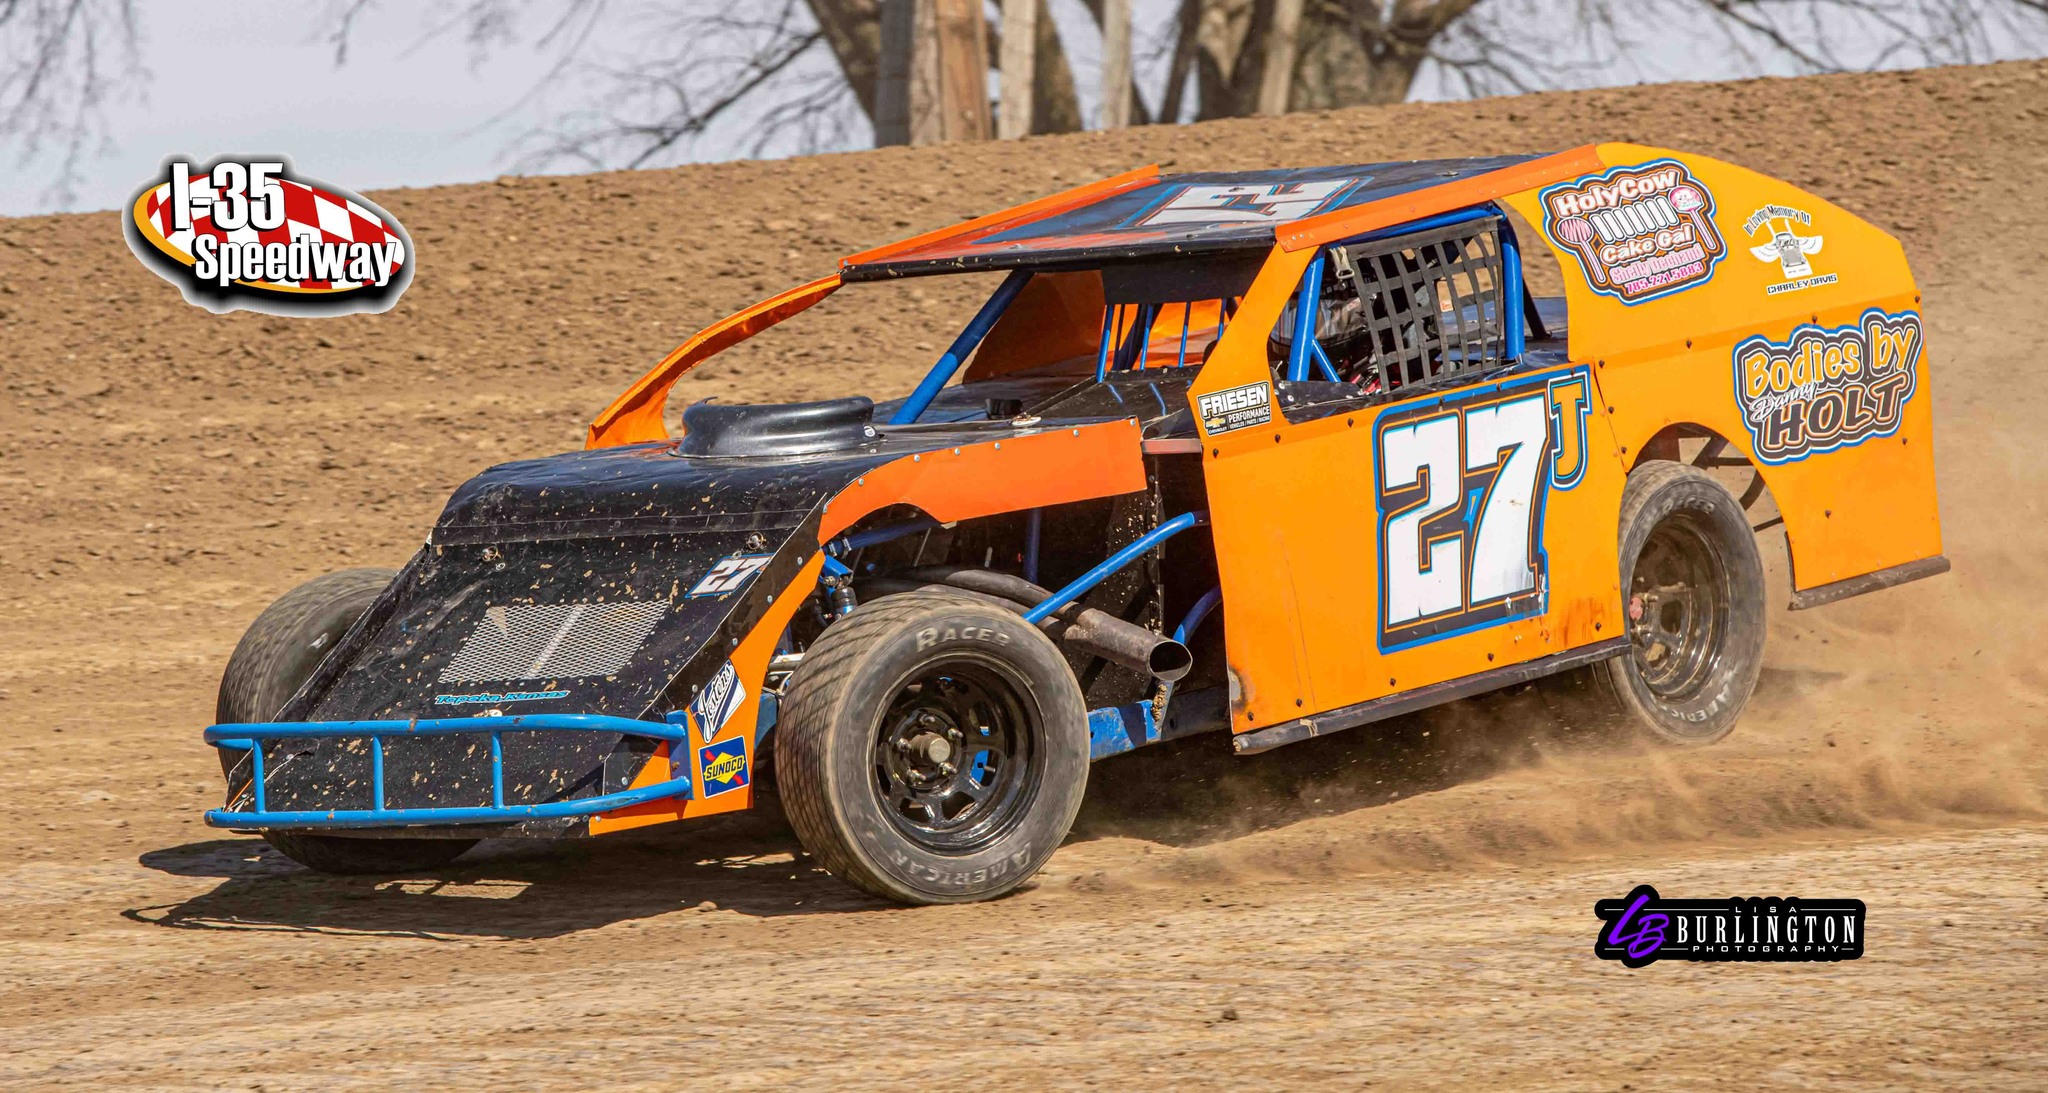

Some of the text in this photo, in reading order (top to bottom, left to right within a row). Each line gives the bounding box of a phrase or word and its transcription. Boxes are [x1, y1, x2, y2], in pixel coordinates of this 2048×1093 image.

[1748, 209, 1771, 229] Loving
[1766, 205, 1799, 221] Memory
[1601, 223, 1694, 265] Cake Gal
[1767, 274, 1837, 294] CHARLEY DAVIS
[1744, 323, 1916, 399] Bodies by
[1200, 384, 1268, 417] FRIESEN
[1228, 406, 1270, 423] PERFORMANCE
[1750, 382, 1818, 422] Danny
[1764, 372, 1908, 449] HOLT
[1382, 395, 1547, 627] 27
[690, 557, 770, 595] 27
[916, 626, 1011, 653] RACER
[706, 757, 743, 779] SUNOCO
